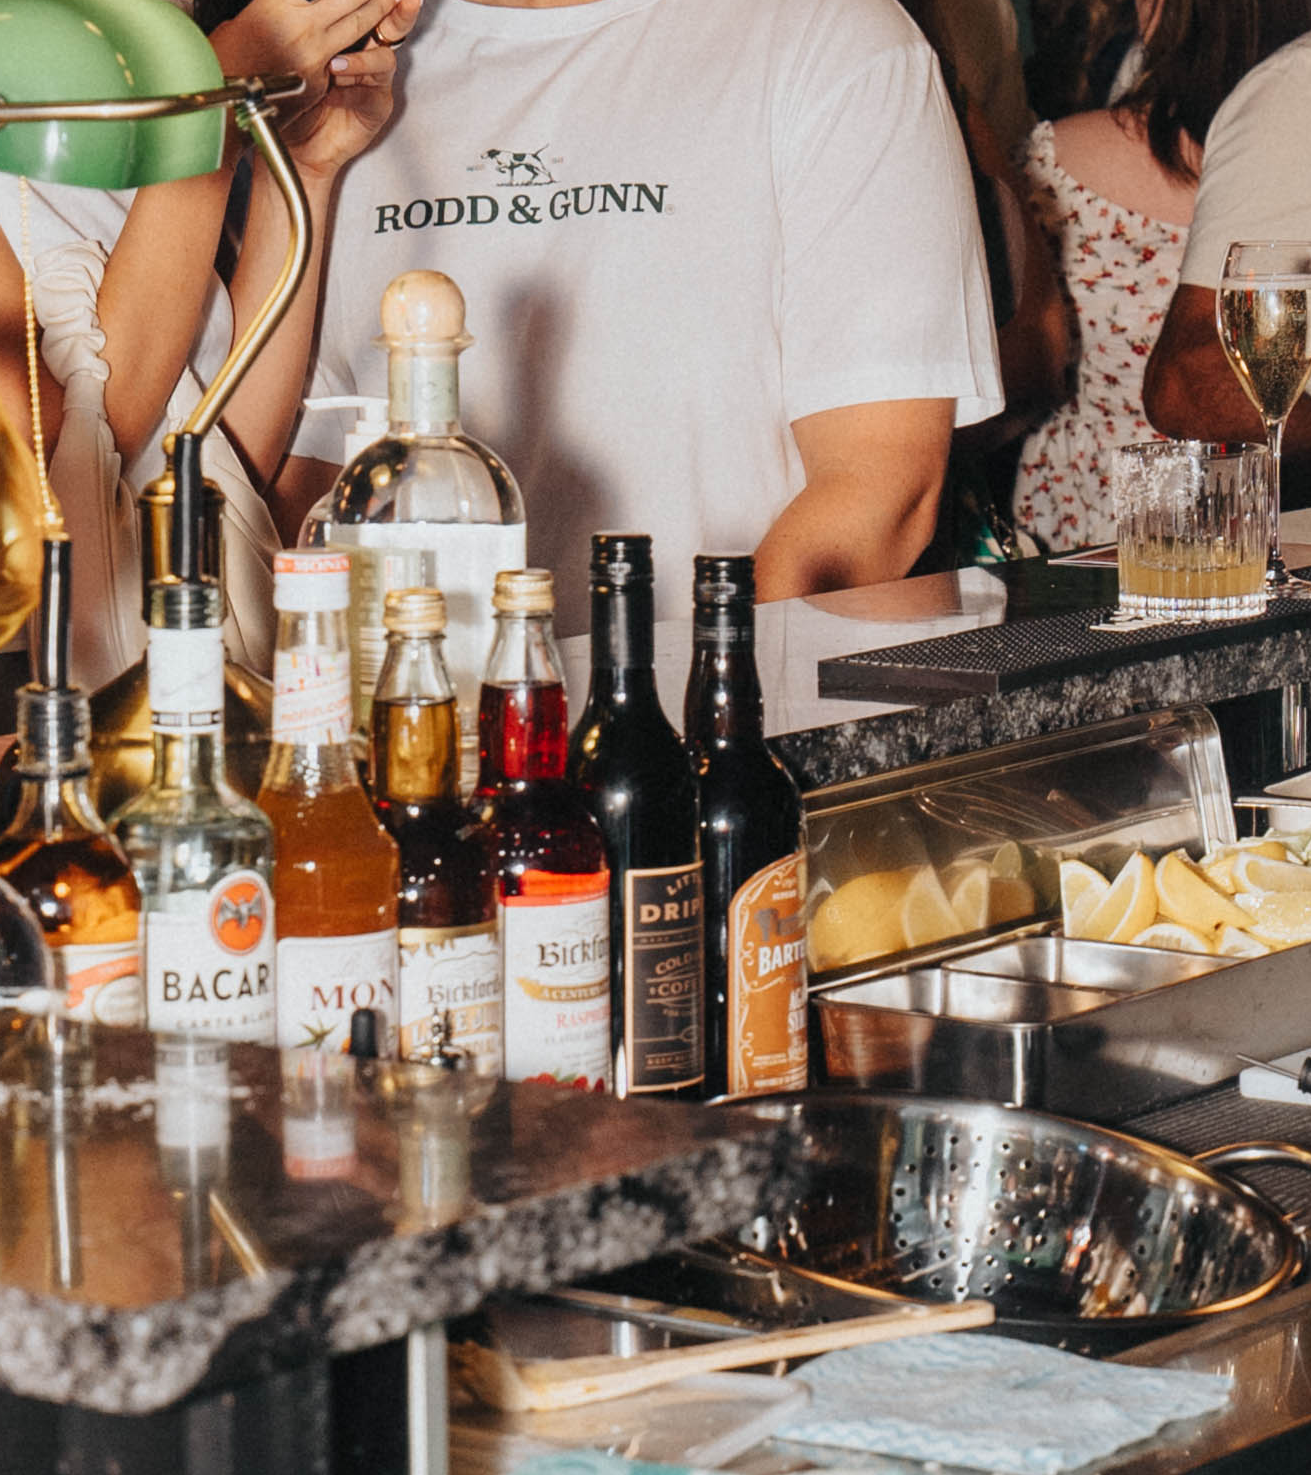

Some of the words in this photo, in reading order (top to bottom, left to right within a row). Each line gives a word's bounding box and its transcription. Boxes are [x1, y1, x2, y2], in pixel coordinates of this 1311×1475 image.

[374, 196, 499, 234] RODD
[507, 194, 543, 225] &
[549, 183, 669, 221] GUNN
